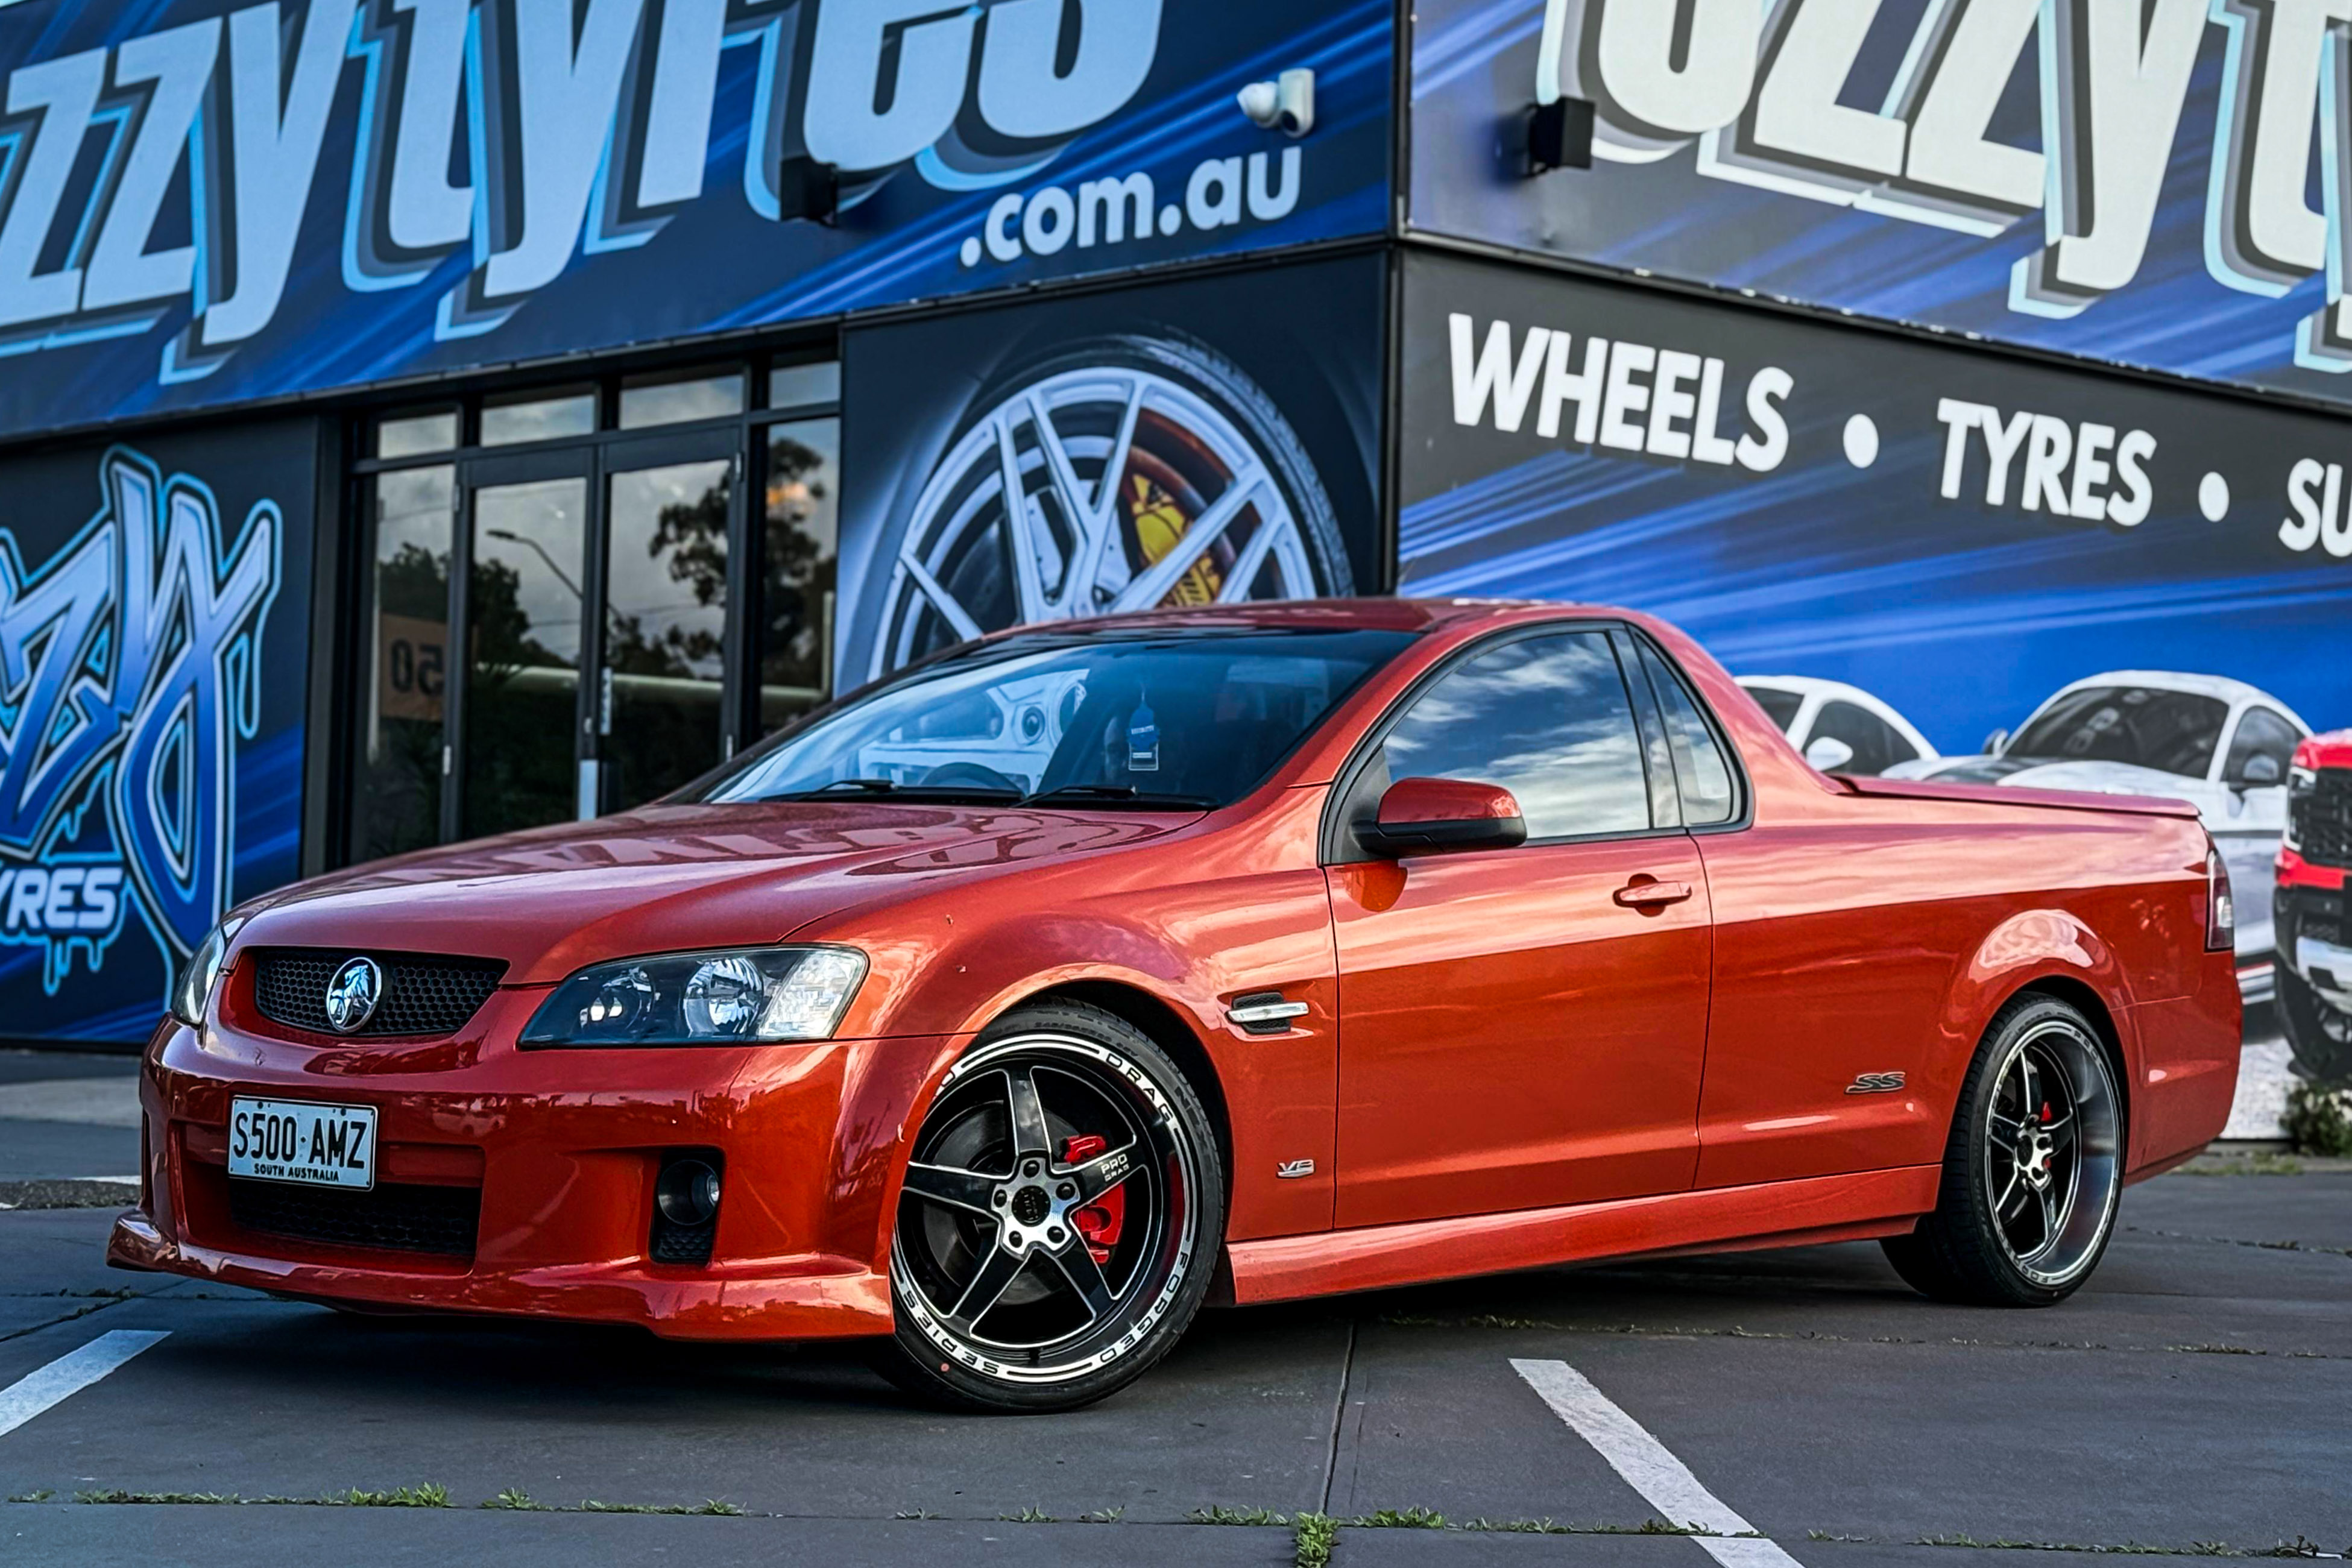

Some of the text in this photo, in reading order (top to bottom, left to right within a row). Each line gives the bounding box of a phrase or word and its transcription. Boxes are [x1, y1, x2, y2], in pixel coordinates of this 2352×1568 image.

[960, 145, 1302, 268] .com.au
[1449, 312, 1795, 473] WHEELS
[1937, 397, 2158, 527] TYRES
[254, 1163, 339, 1182] SOUTH AUSTRALIA
[1101, 1154, 1127, 1174] PRO
[1104, 1163, 1130, 1182] DRAG
[903, 1053, 1189, 1375] DRAG FORGED SERIES
